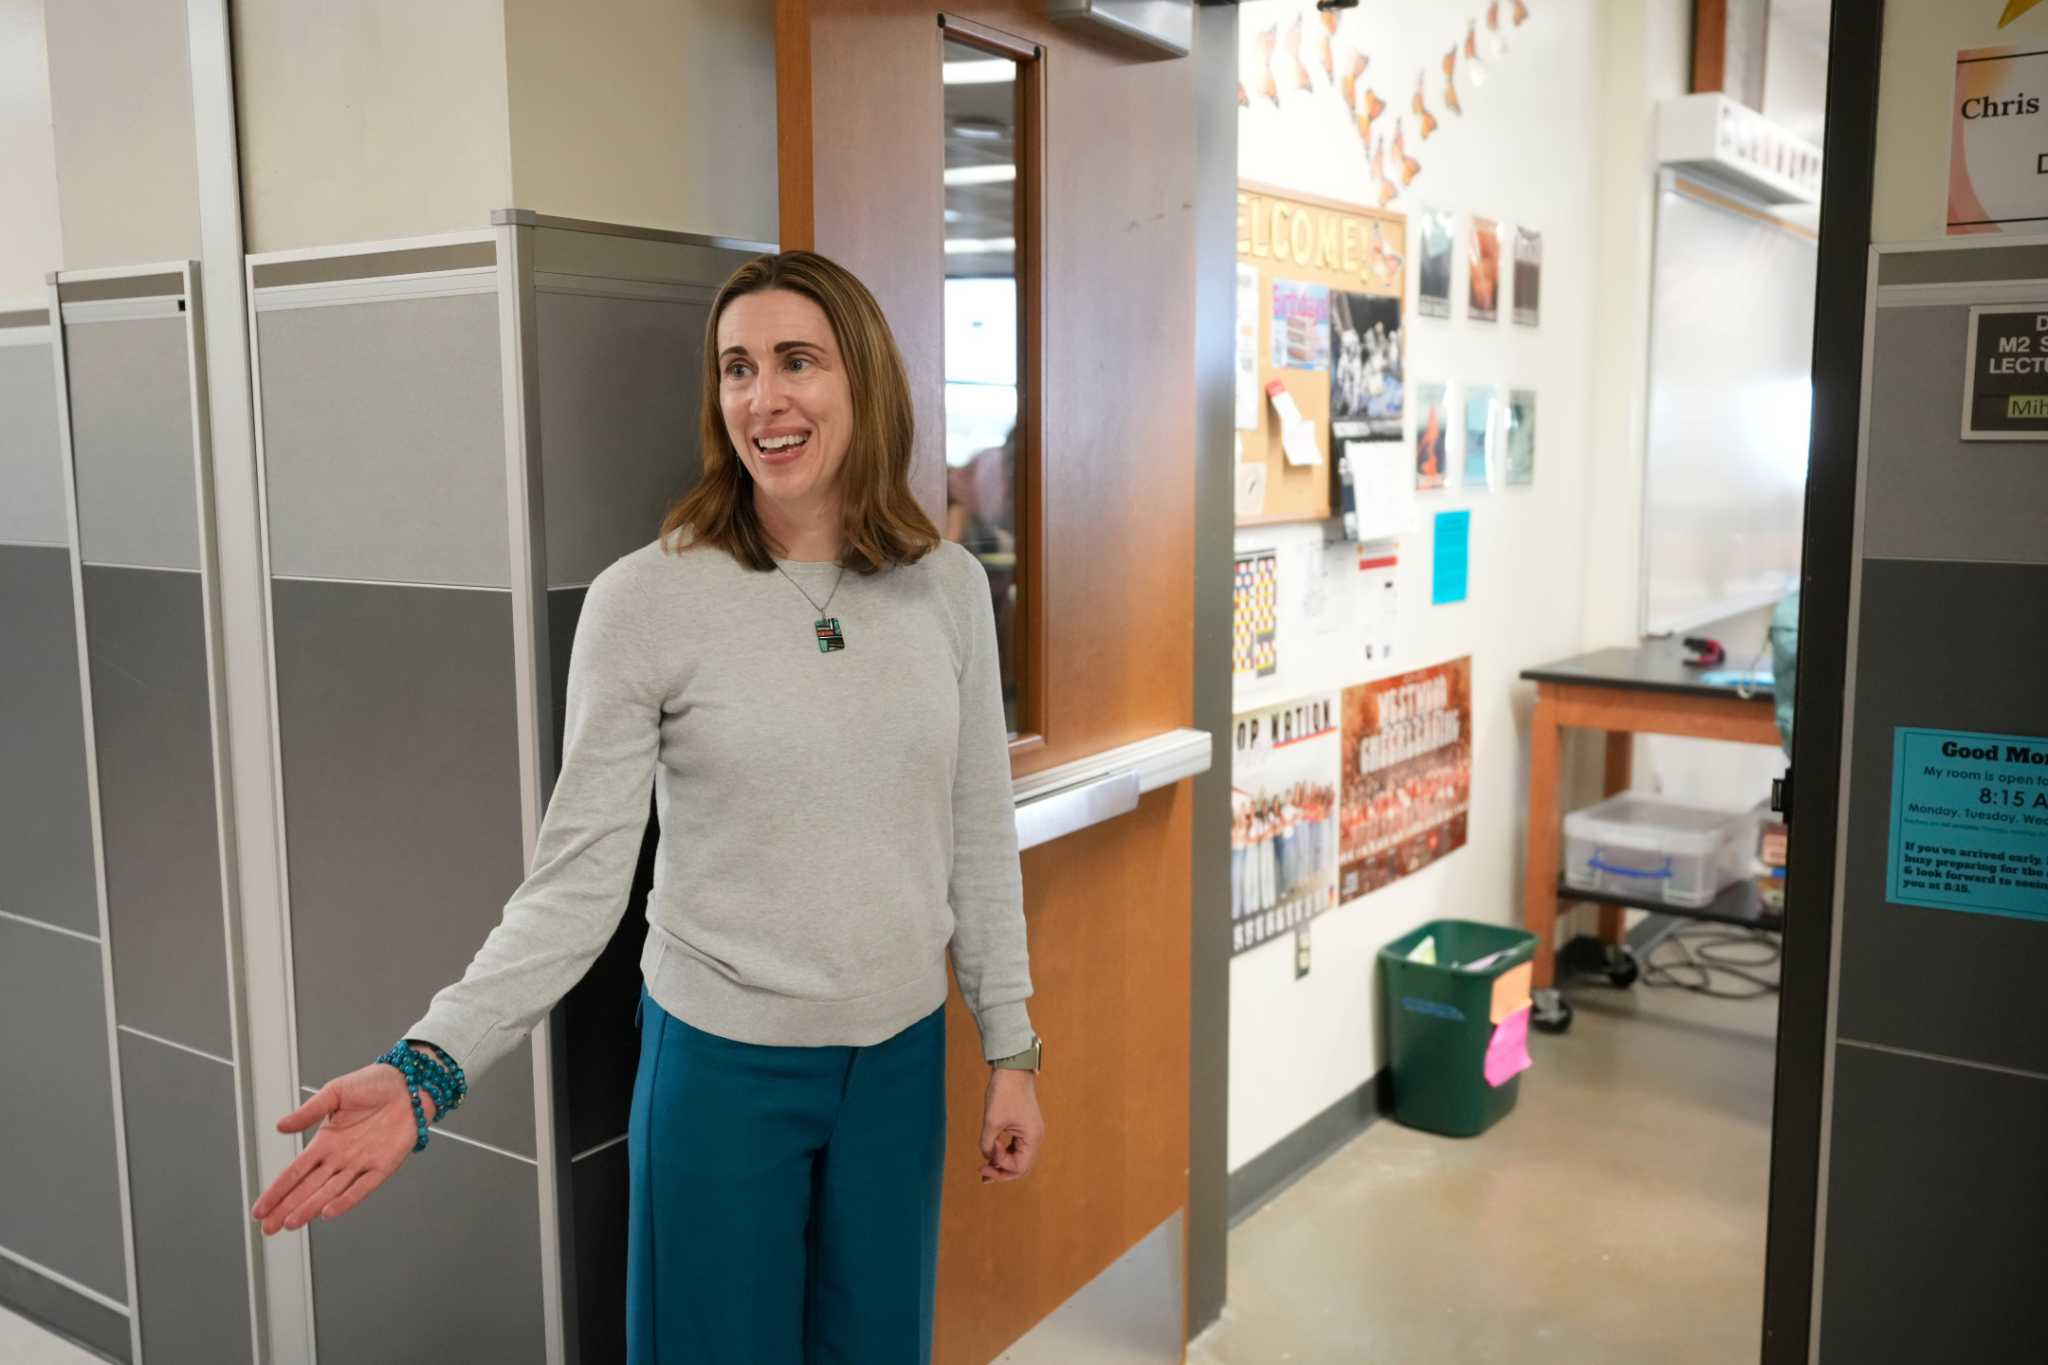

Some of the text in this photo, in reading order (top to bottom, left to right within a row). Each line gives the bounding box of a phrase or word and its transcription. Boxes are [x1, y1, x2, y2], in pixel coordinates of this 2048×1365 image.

[1961, 93, 2040, 120] Chris
[1999, 336, 2031, 353] M2
[1271, 699, 1330, 744] NATION
[1942, 741, 1999, 761] Good
[1923, 766, 1943, 779] My
[1946, 768, 1981, 780] room
[1984, 770, 1994, 782] is
[1999, 773, 2033, 786] open
[1979, 788, 2025, 807] 8:15
[1905, 841, 1915, 851] If
[1960, 847, 2006, 861] arrived
[1903, 865, 1912, 875] &
[1916, 865, 1942, 878] look
[1945, 869, 1996, 884] forward
[1999, 875, 2012, 886] to
[1904, 853, 1932, 866] busy
[1936, 856, 1997, 874] preparing
[2000, 863, 2018, 875] for
[2022, 865, 2043, 878] the
[1903, 878, 1925, 889] you
[1928, 880, 1941, 890] at
